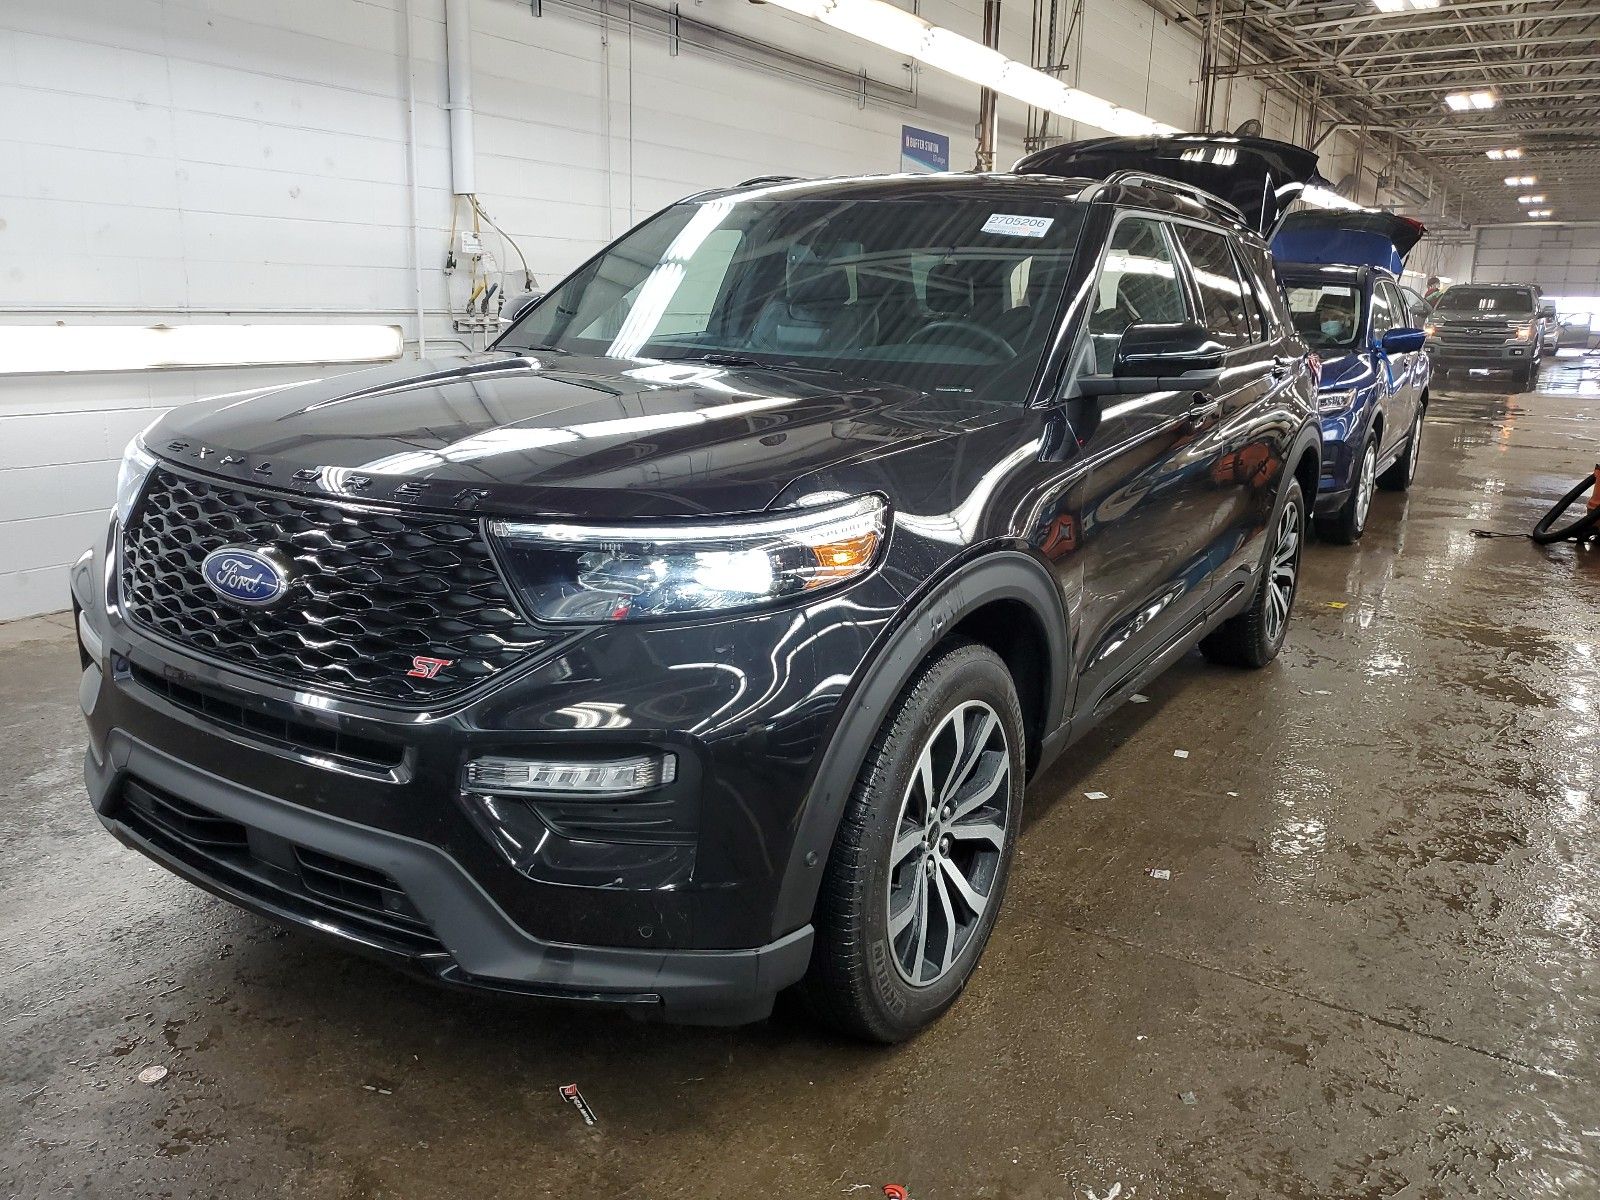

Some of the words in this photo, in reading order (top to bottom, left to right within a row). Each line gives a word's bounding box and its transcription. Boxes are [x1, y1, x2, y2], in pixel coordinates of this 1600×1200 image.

[925, 141, 939, 153] STATION
[989, 216, 1047, 228] 2705206
[167, 441, 491, 502] EXPLORER
[216, 558, 264, 593] Ford
[407, 656, 454, 679] ST
